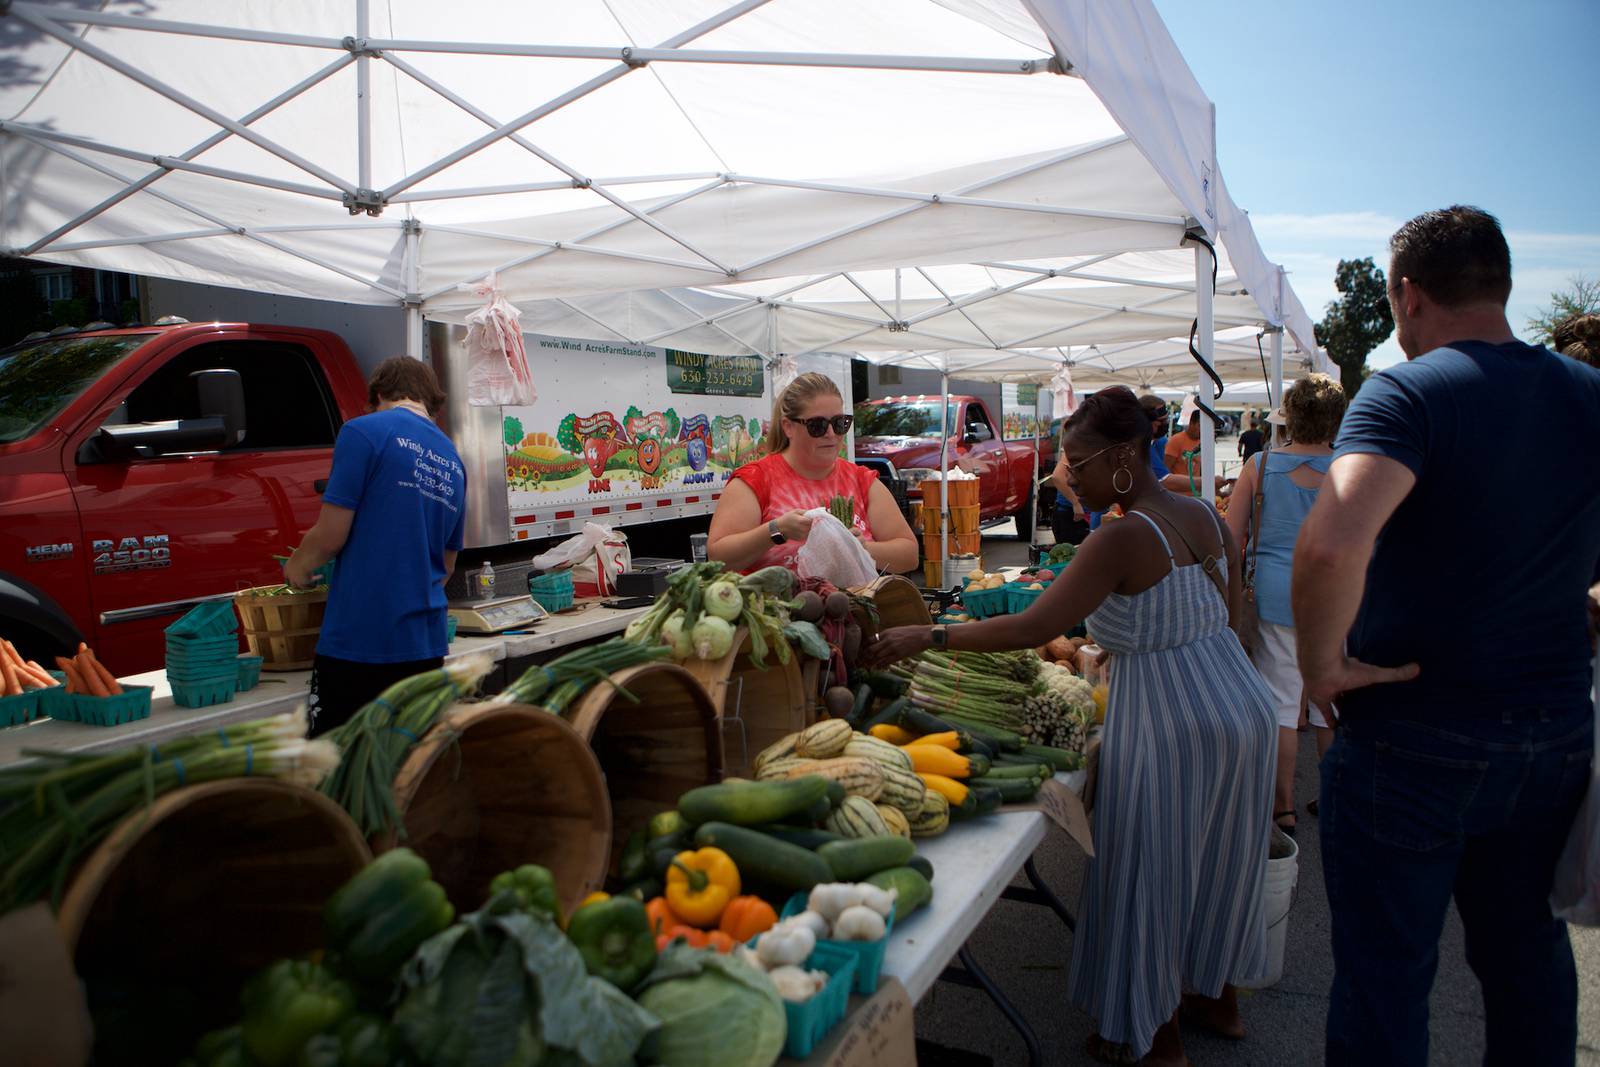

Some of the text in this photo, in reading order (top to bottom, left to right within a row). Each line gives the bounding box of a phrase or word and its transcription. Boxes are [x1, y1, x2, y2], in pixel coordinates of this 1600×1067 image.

[681, 369, 753, 386] 630-232-6429
[396, 437, 424, 457] Windy
[425, 449, 450, 468] Acres
[588, 478, 611, 494] JUNE
[683, 472, 715, 485] AUGUST
[26, 543, 74, 556] HEMI
[92, 534, 170, 552] RAM
[93, 547, 170, 564] 4500
